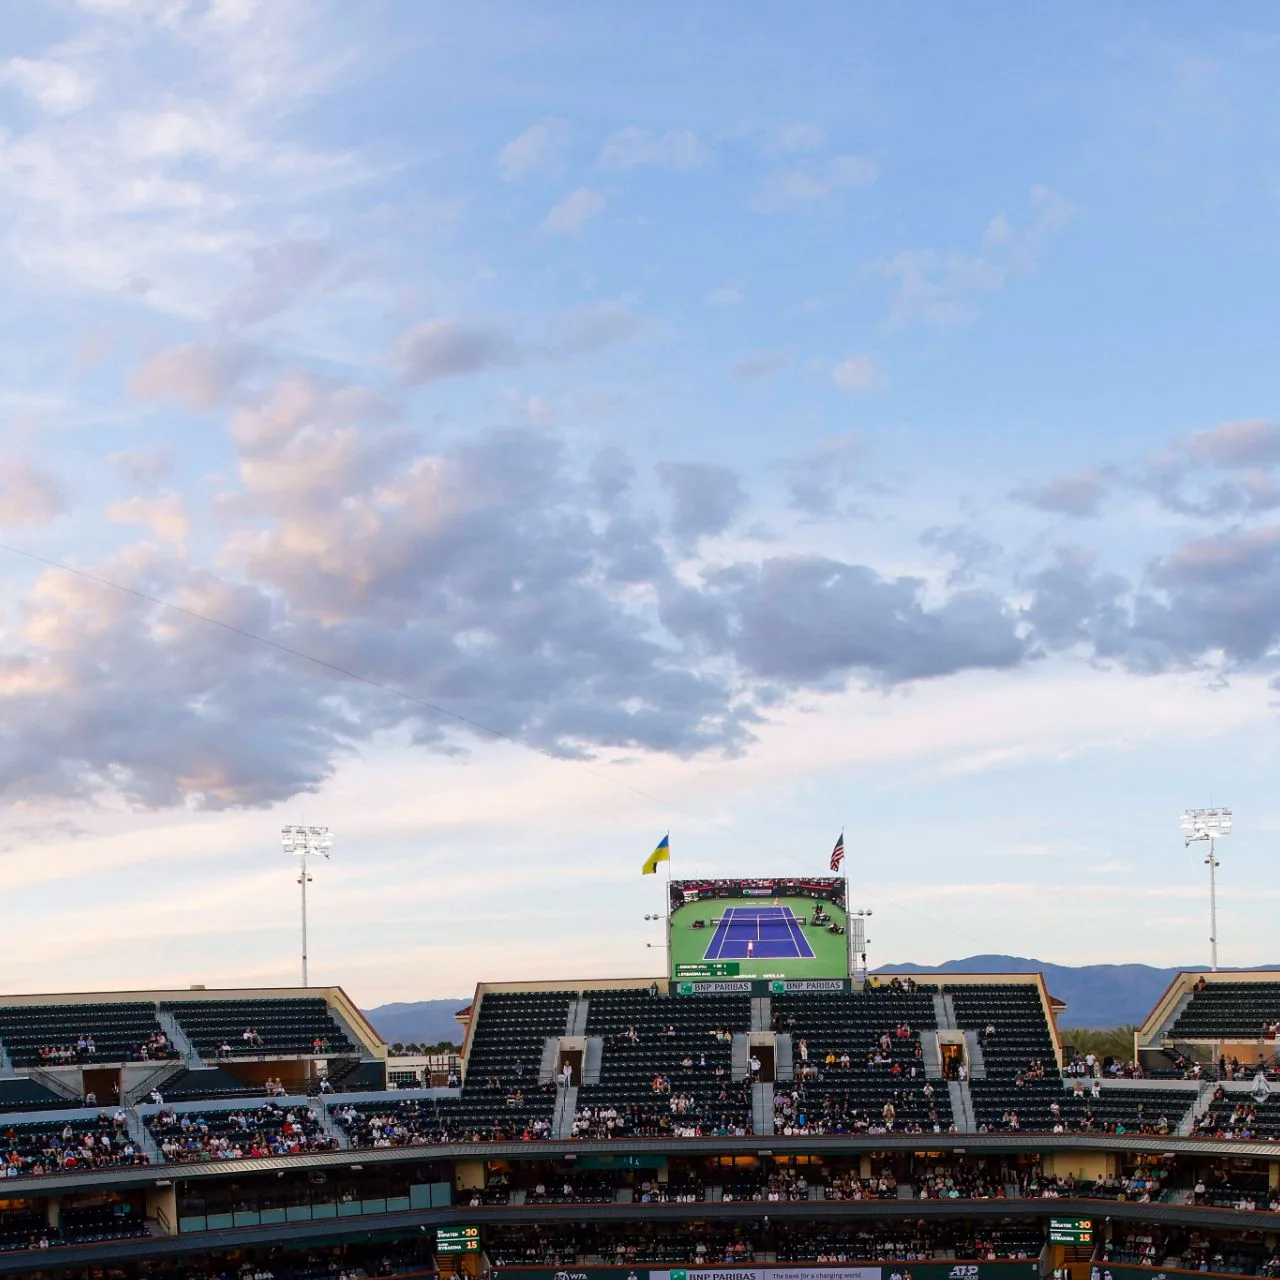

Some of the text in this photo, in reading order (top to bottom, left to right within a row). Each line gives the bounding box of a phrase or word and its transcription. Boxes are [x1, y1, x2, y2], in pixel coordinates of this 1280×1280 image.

[1078, 1220, 1091, 1229] 30
[465, 1228, 478, 1236] 30
[466, 1241, 478, 1249] 15
[949, 1265, 979, 1275] ATP
[712, 1273, 756, 1280] PARIBAS
